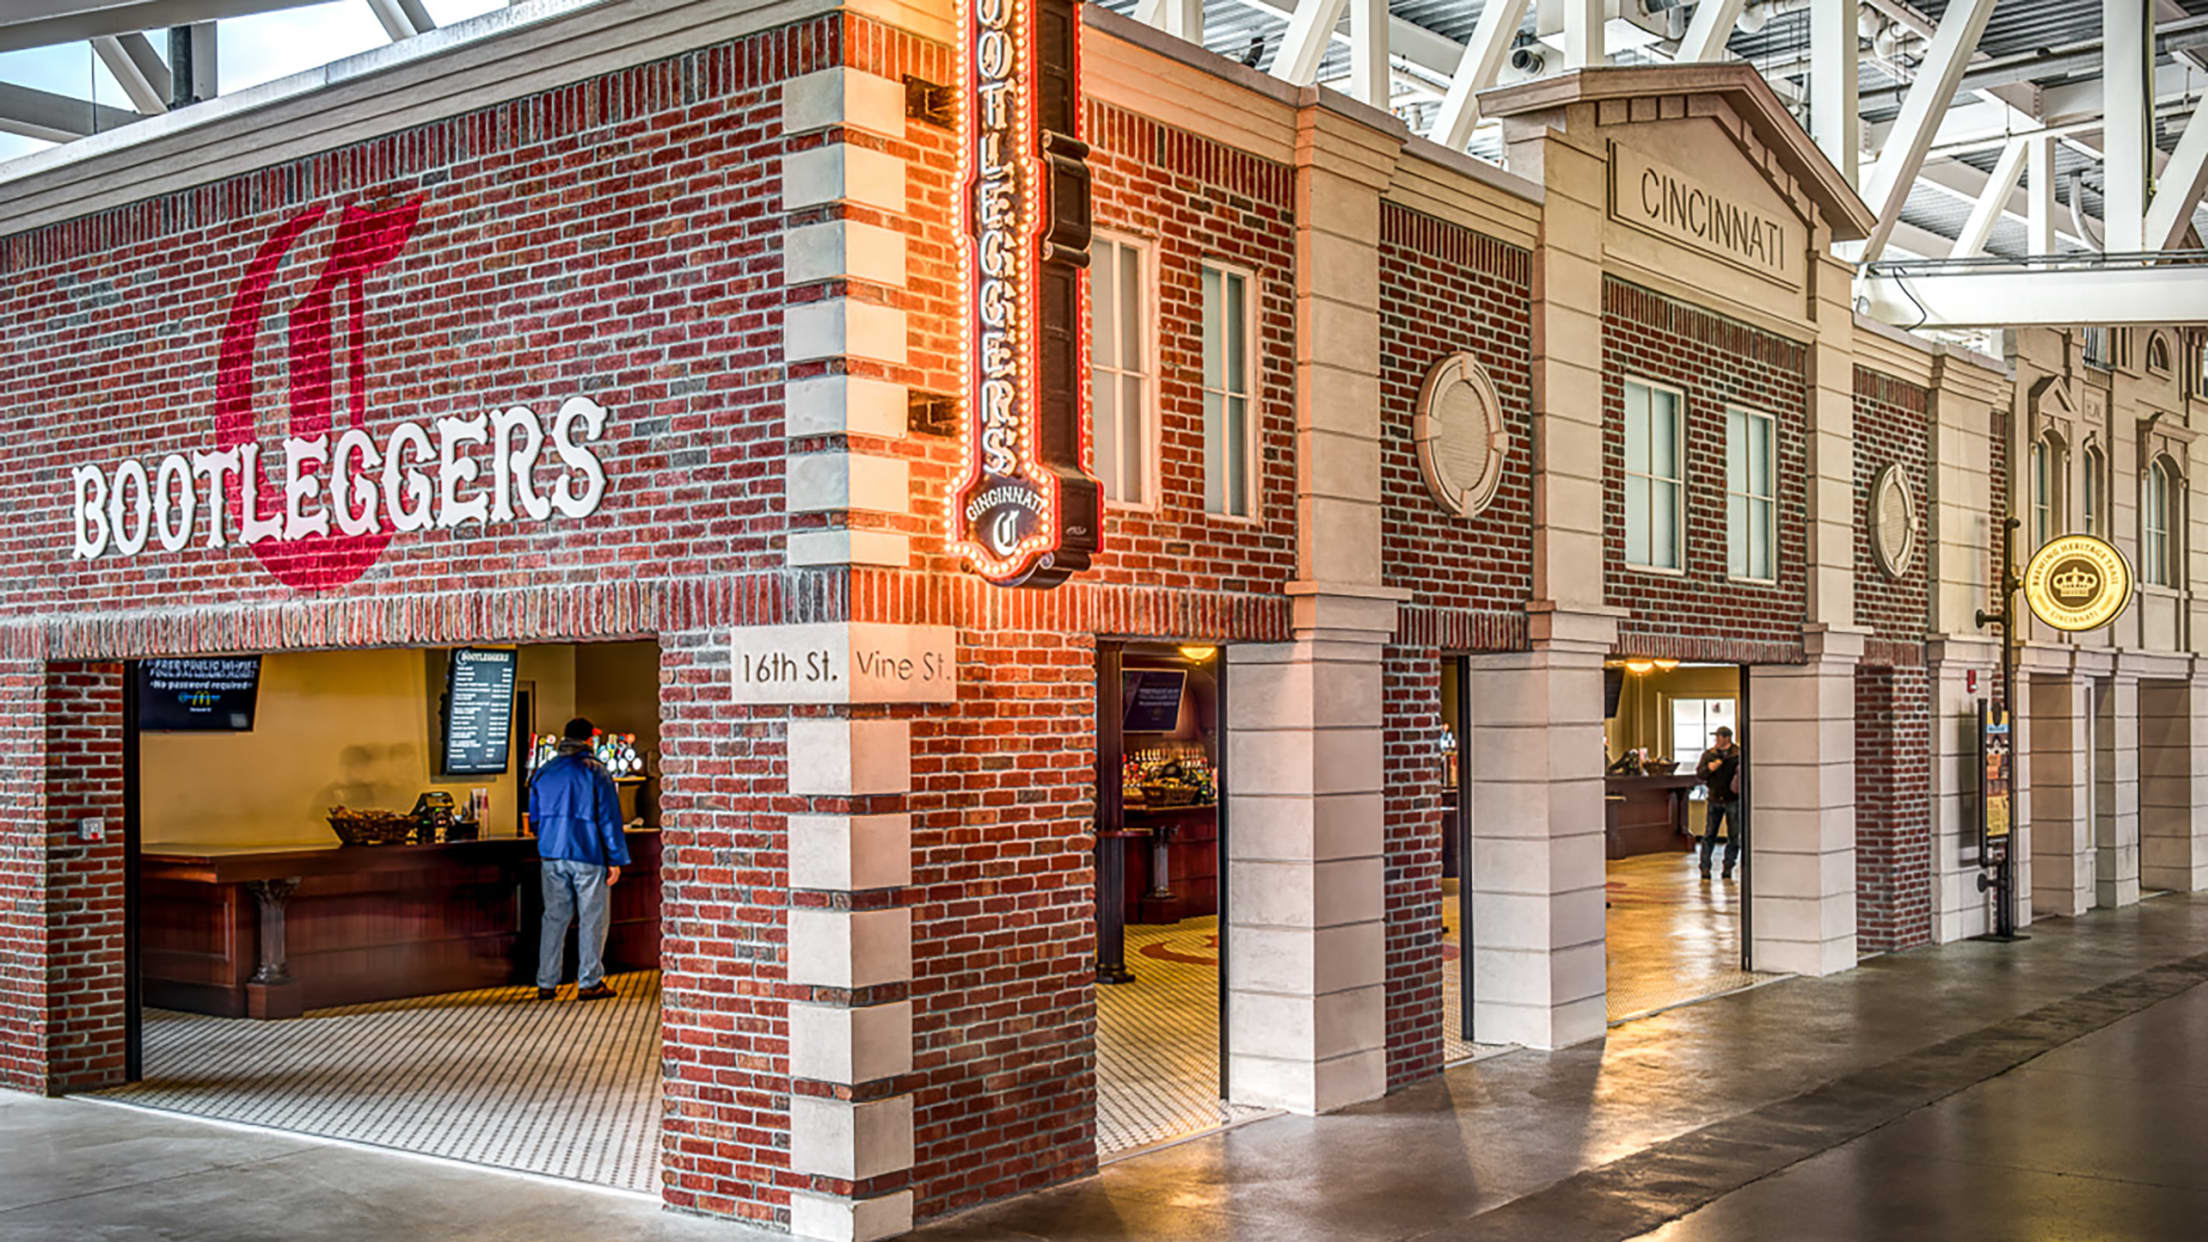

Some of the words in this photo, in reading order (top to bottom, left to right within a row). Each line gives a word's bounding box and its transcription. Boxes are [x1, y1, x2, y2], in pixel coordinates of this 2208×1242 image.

[1642, 168, 1784, 270] CINCINNATI
[73, 397, 608, 560] BOOTLEGGERS
[965, 486, 1043, 521] CINCINNATI
[2032, 547, 2060, 587] BREWING
[2060, 543, 2107, 563] HERITAGE
[744, 651, 797, 683] 16th
[806, 650, 838, 682] St.
[856, 650, 914, 681] Vine
[922, 651, 951, 682] St.
